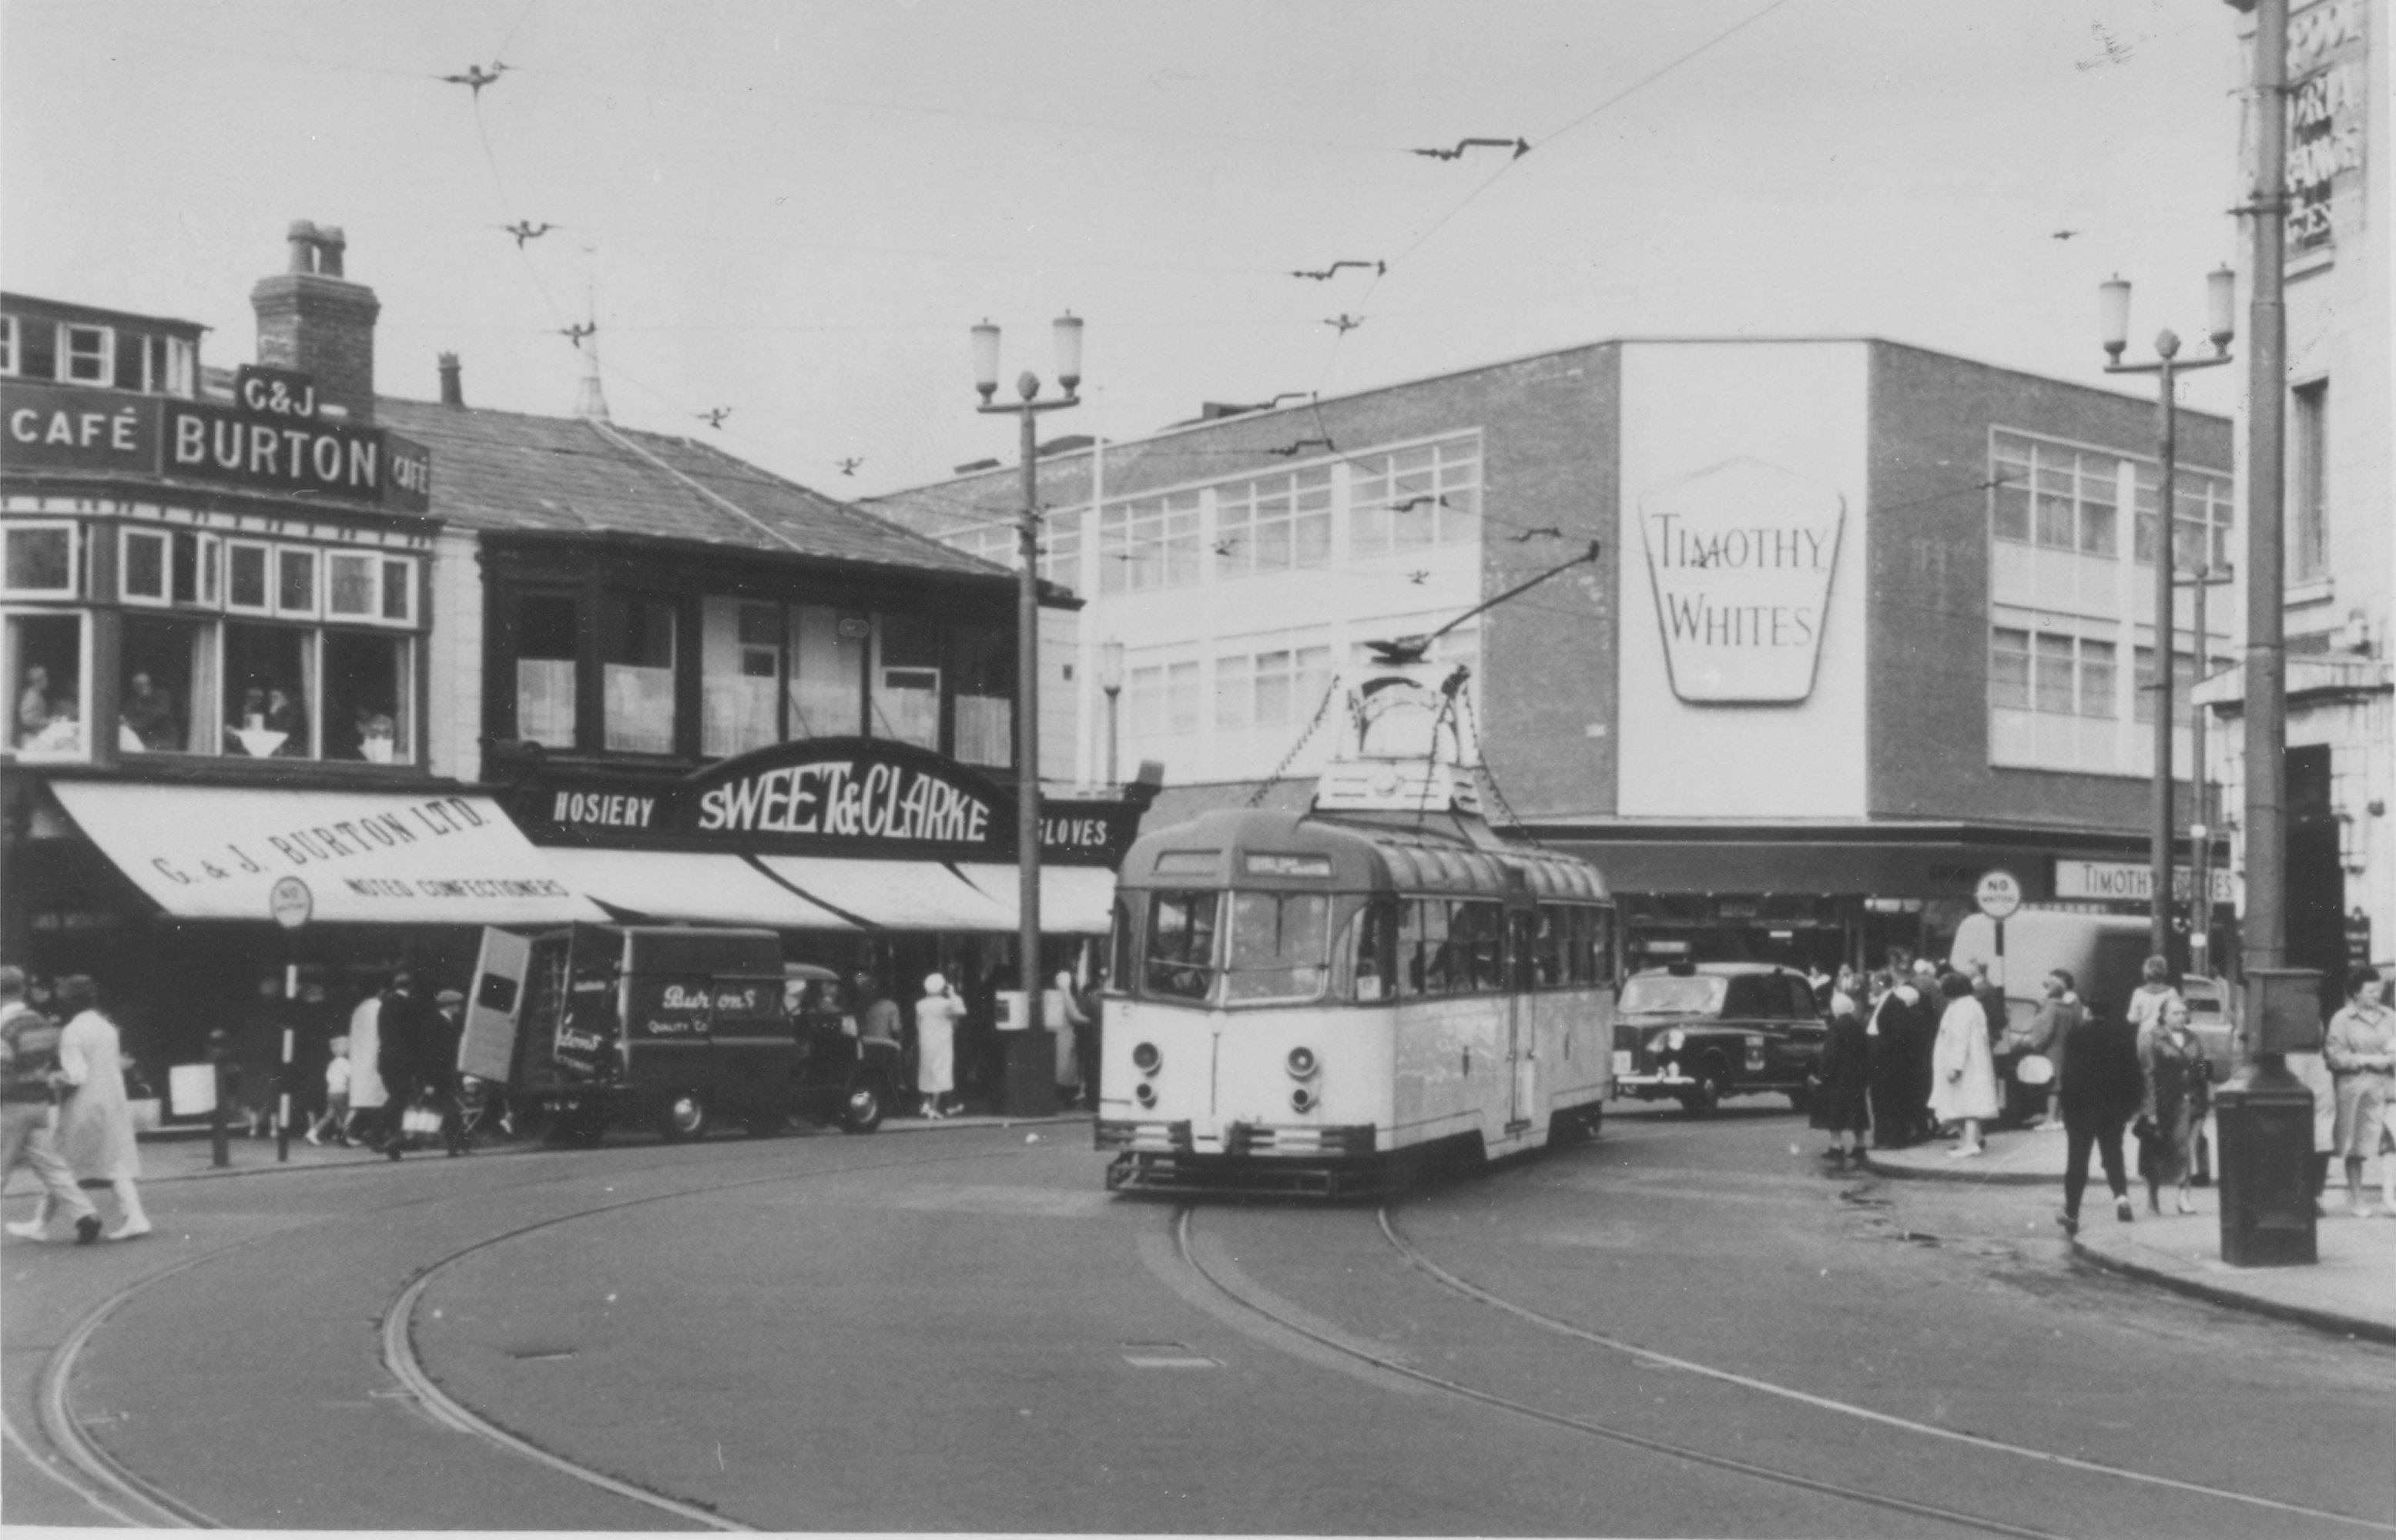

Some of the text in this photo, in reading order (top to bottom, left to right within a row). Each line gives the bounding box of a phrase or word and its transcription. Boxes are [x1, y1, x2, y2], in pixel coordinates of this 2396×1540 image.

[11, 406, 137, 450] CAFÉ
[176, 416, 377, 487] BURTON
[1651, 513, 1827, 568] TIMOTHY
[1667, 593, 1812, 647] WHITES
[553, 791, 655, 828] HOSIERY
[201, 860, 230, 879] &
[267, 812, 417, 865] BURTON
[408, 798, 491, 836] LTD.
[1987, 879, 2009, 892] NO
[2083, 863, 2155, 896] TIMOTH
